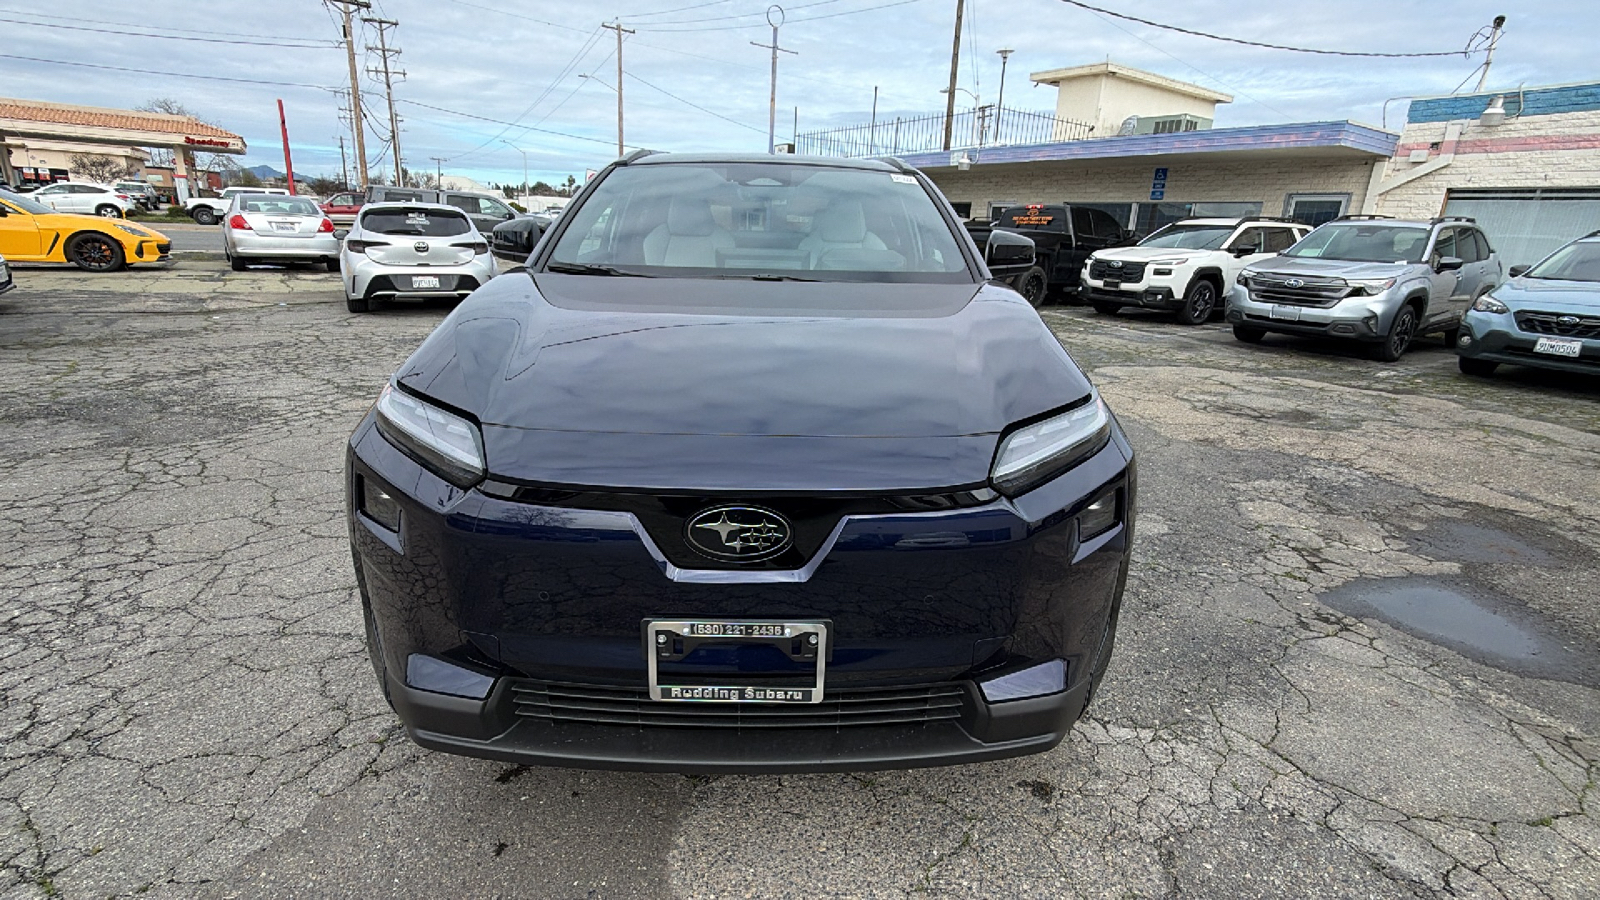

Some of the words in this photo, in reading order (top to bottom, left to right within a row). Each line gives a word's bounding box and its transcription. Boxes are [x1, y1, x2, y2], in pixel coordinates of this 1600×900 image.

[184, 136, 230, 148] Speedway
[693, 623, 724, 635] (530)
[671, 687, 739, 700] Redding
[744, 687, 803, 701] Subaru
